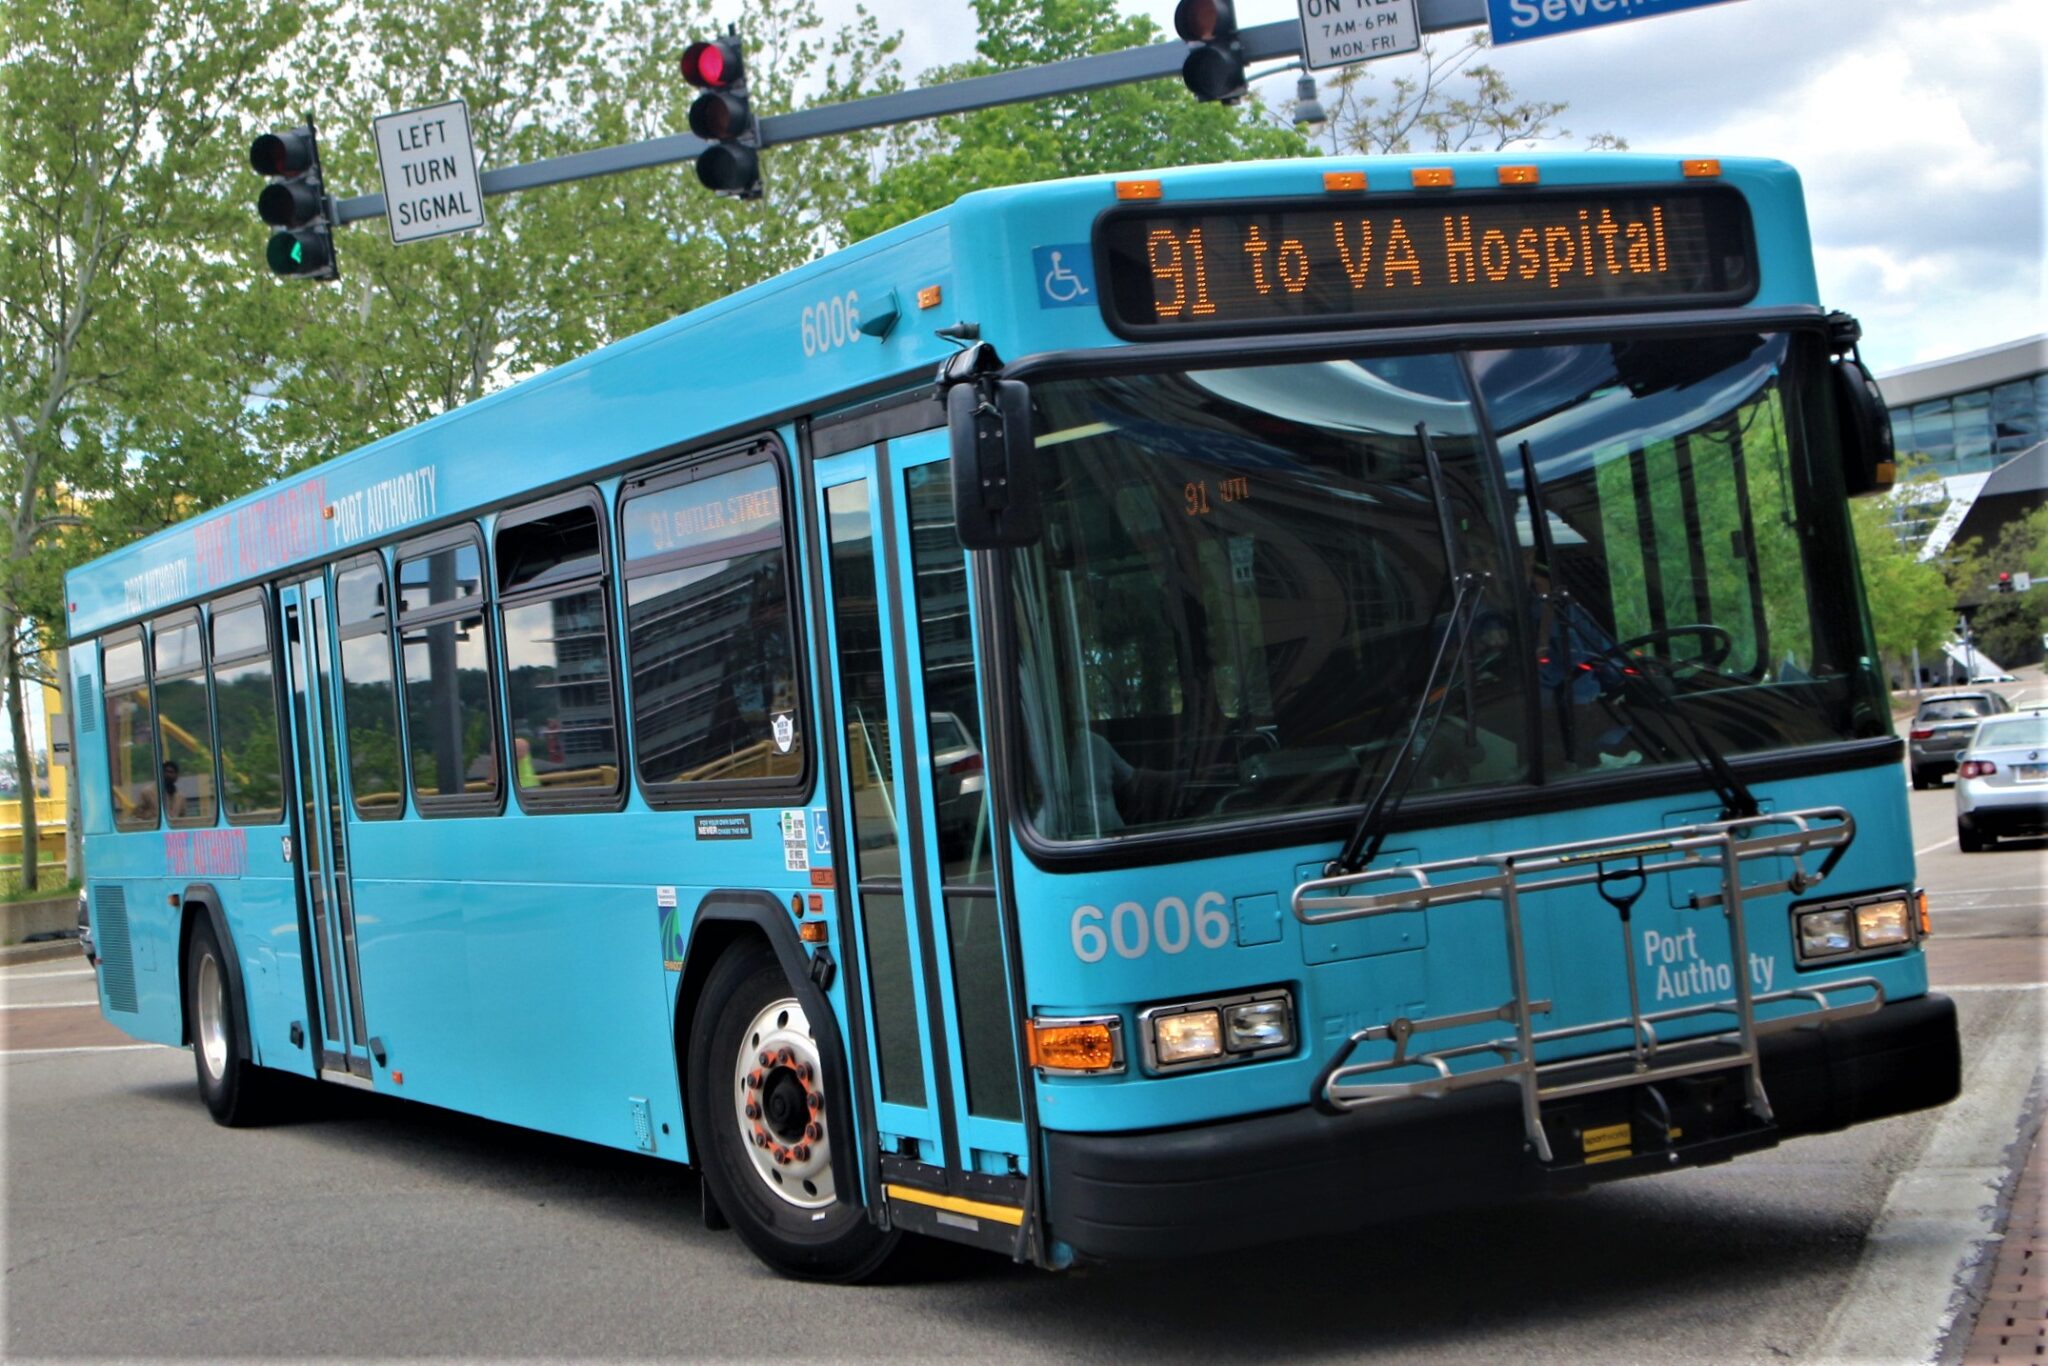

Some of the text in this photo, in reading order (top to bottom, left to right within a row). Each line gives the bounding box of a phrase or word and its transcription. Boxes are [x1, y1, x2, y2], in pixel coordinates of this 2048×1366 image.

[398, 120, 446, 152] LEFT
[401, 155, 457, 187] TURN
[399, 191, 473, 225] SIGNAL
[1146, 206, 1668, 317] 91 to VA Hospital
[802, 289, 862, 358] 6006
[332, 464, 437, 545] PORT AUTHORITY
[1184, 480, 1210, 516] 91
[651, 509, 674, 550] 91
[698, 826, 718, 835] NEVER
[1071, 890, 1231, 963] 6006
[1644, 926, 1699, 967] Port
[1656, 952, 1775, 1001] Authoty
